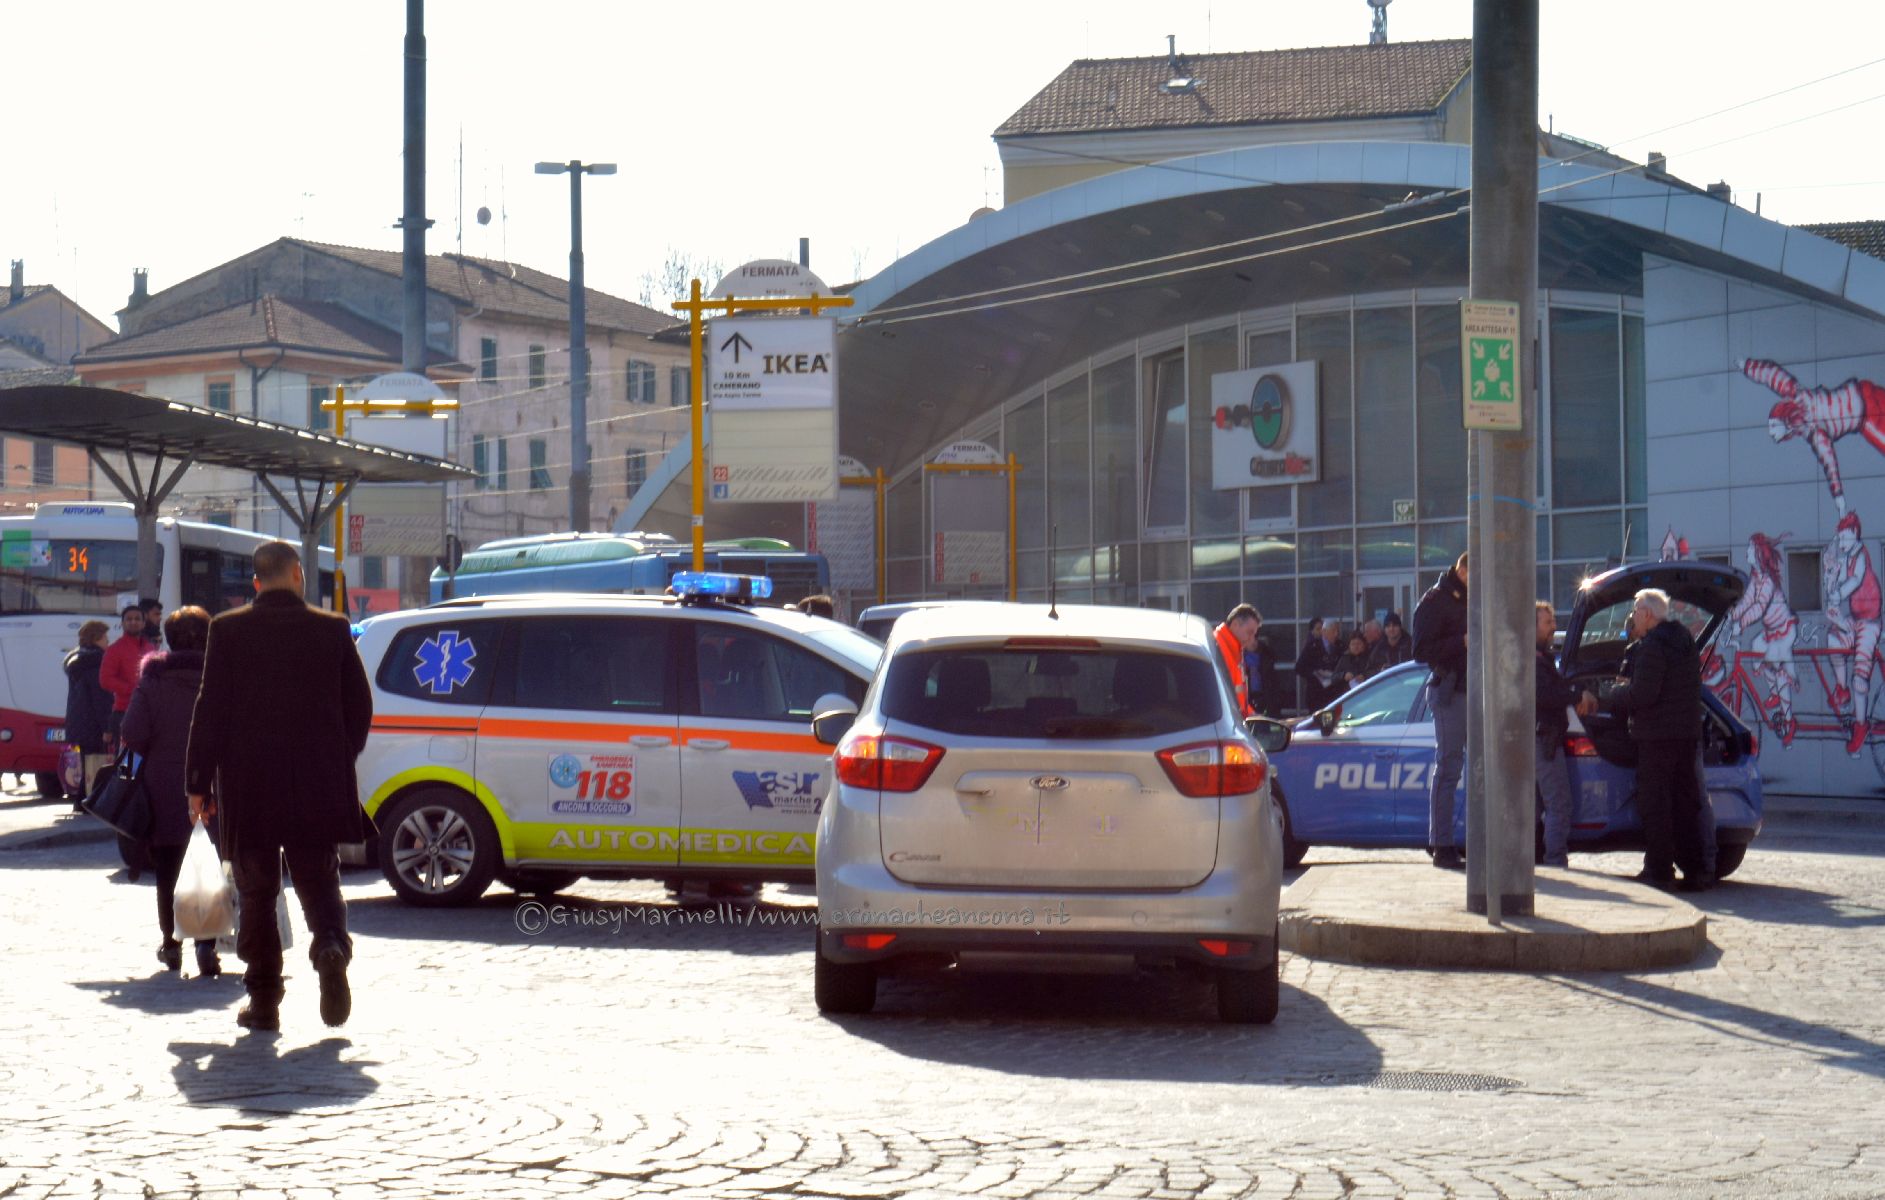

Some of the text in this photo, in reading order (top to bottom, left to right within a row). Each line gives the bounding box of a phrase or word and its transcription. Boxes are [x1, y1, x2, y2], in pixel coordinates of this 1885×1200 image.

[742, 265, 799, 277] FERMATA
[762, 354, 828, 374] IKEA
[724, 371, 751, 379] 10 Km
[380, 378, 423, 387] FERMATA
[713, 382, 761, 390] CAMERANO
[953, 445, 986, 453] FERMATA
[714, 467, 728, 480] 22
[68, 546, 88, 573] 34
[577, 771, 632, 800] 118
[774, 796, 812, 804] marche
[557, 802, 628, 813] ANCONA SOCCORSO
[549, 829, 814, 854] AUTOMEDICA
